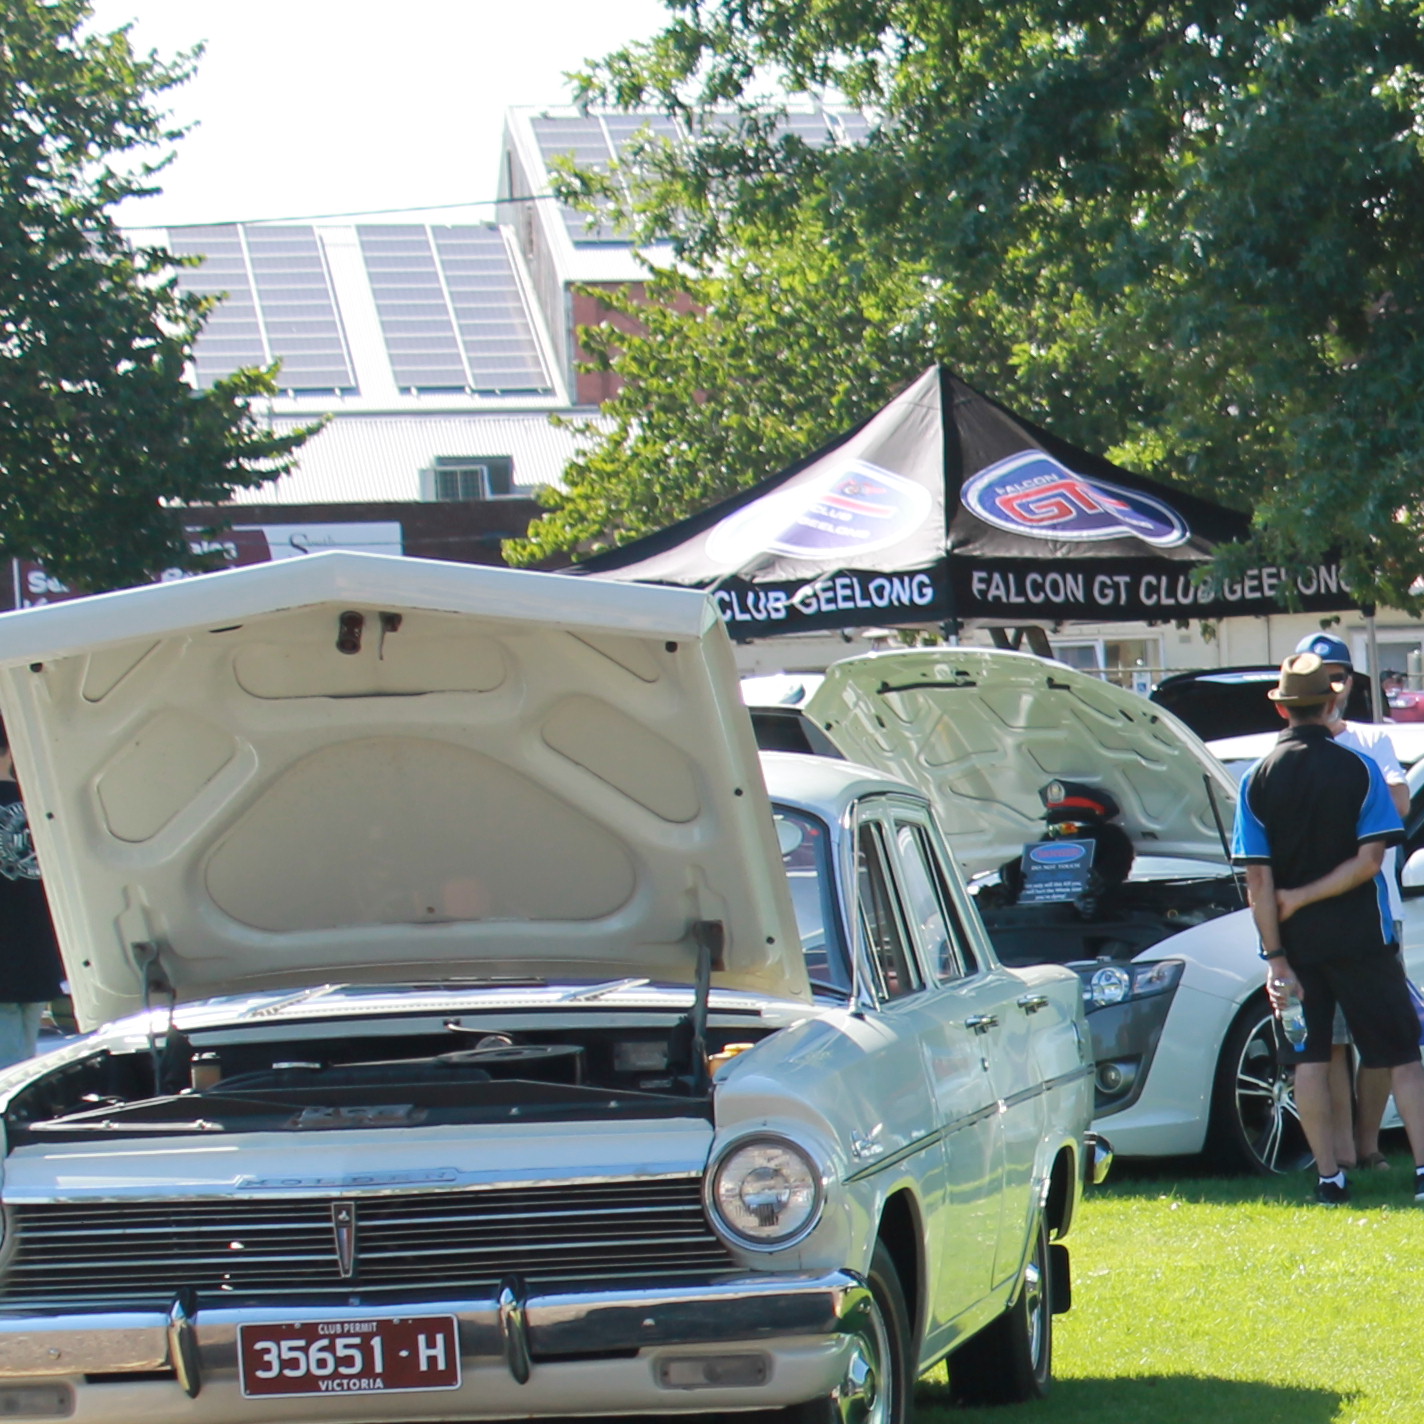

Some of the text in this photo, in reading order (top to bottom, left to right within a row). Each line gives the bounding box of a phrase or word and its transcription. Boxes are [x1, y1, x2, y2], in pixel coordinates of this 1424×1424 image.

[994, 472, 1060, 497] FALCON
[714, 573, 935, 622] CLUB GEELONG
[971, 570, 1086, 604] FALCON
[1093, 574, 1131, 605] GT
[1139, 572, 1216, 605] CLUB
[317, 1321, 378, 1335] CLUB PERMIT
[317, 1377, 385, 1391] VICTORIA
